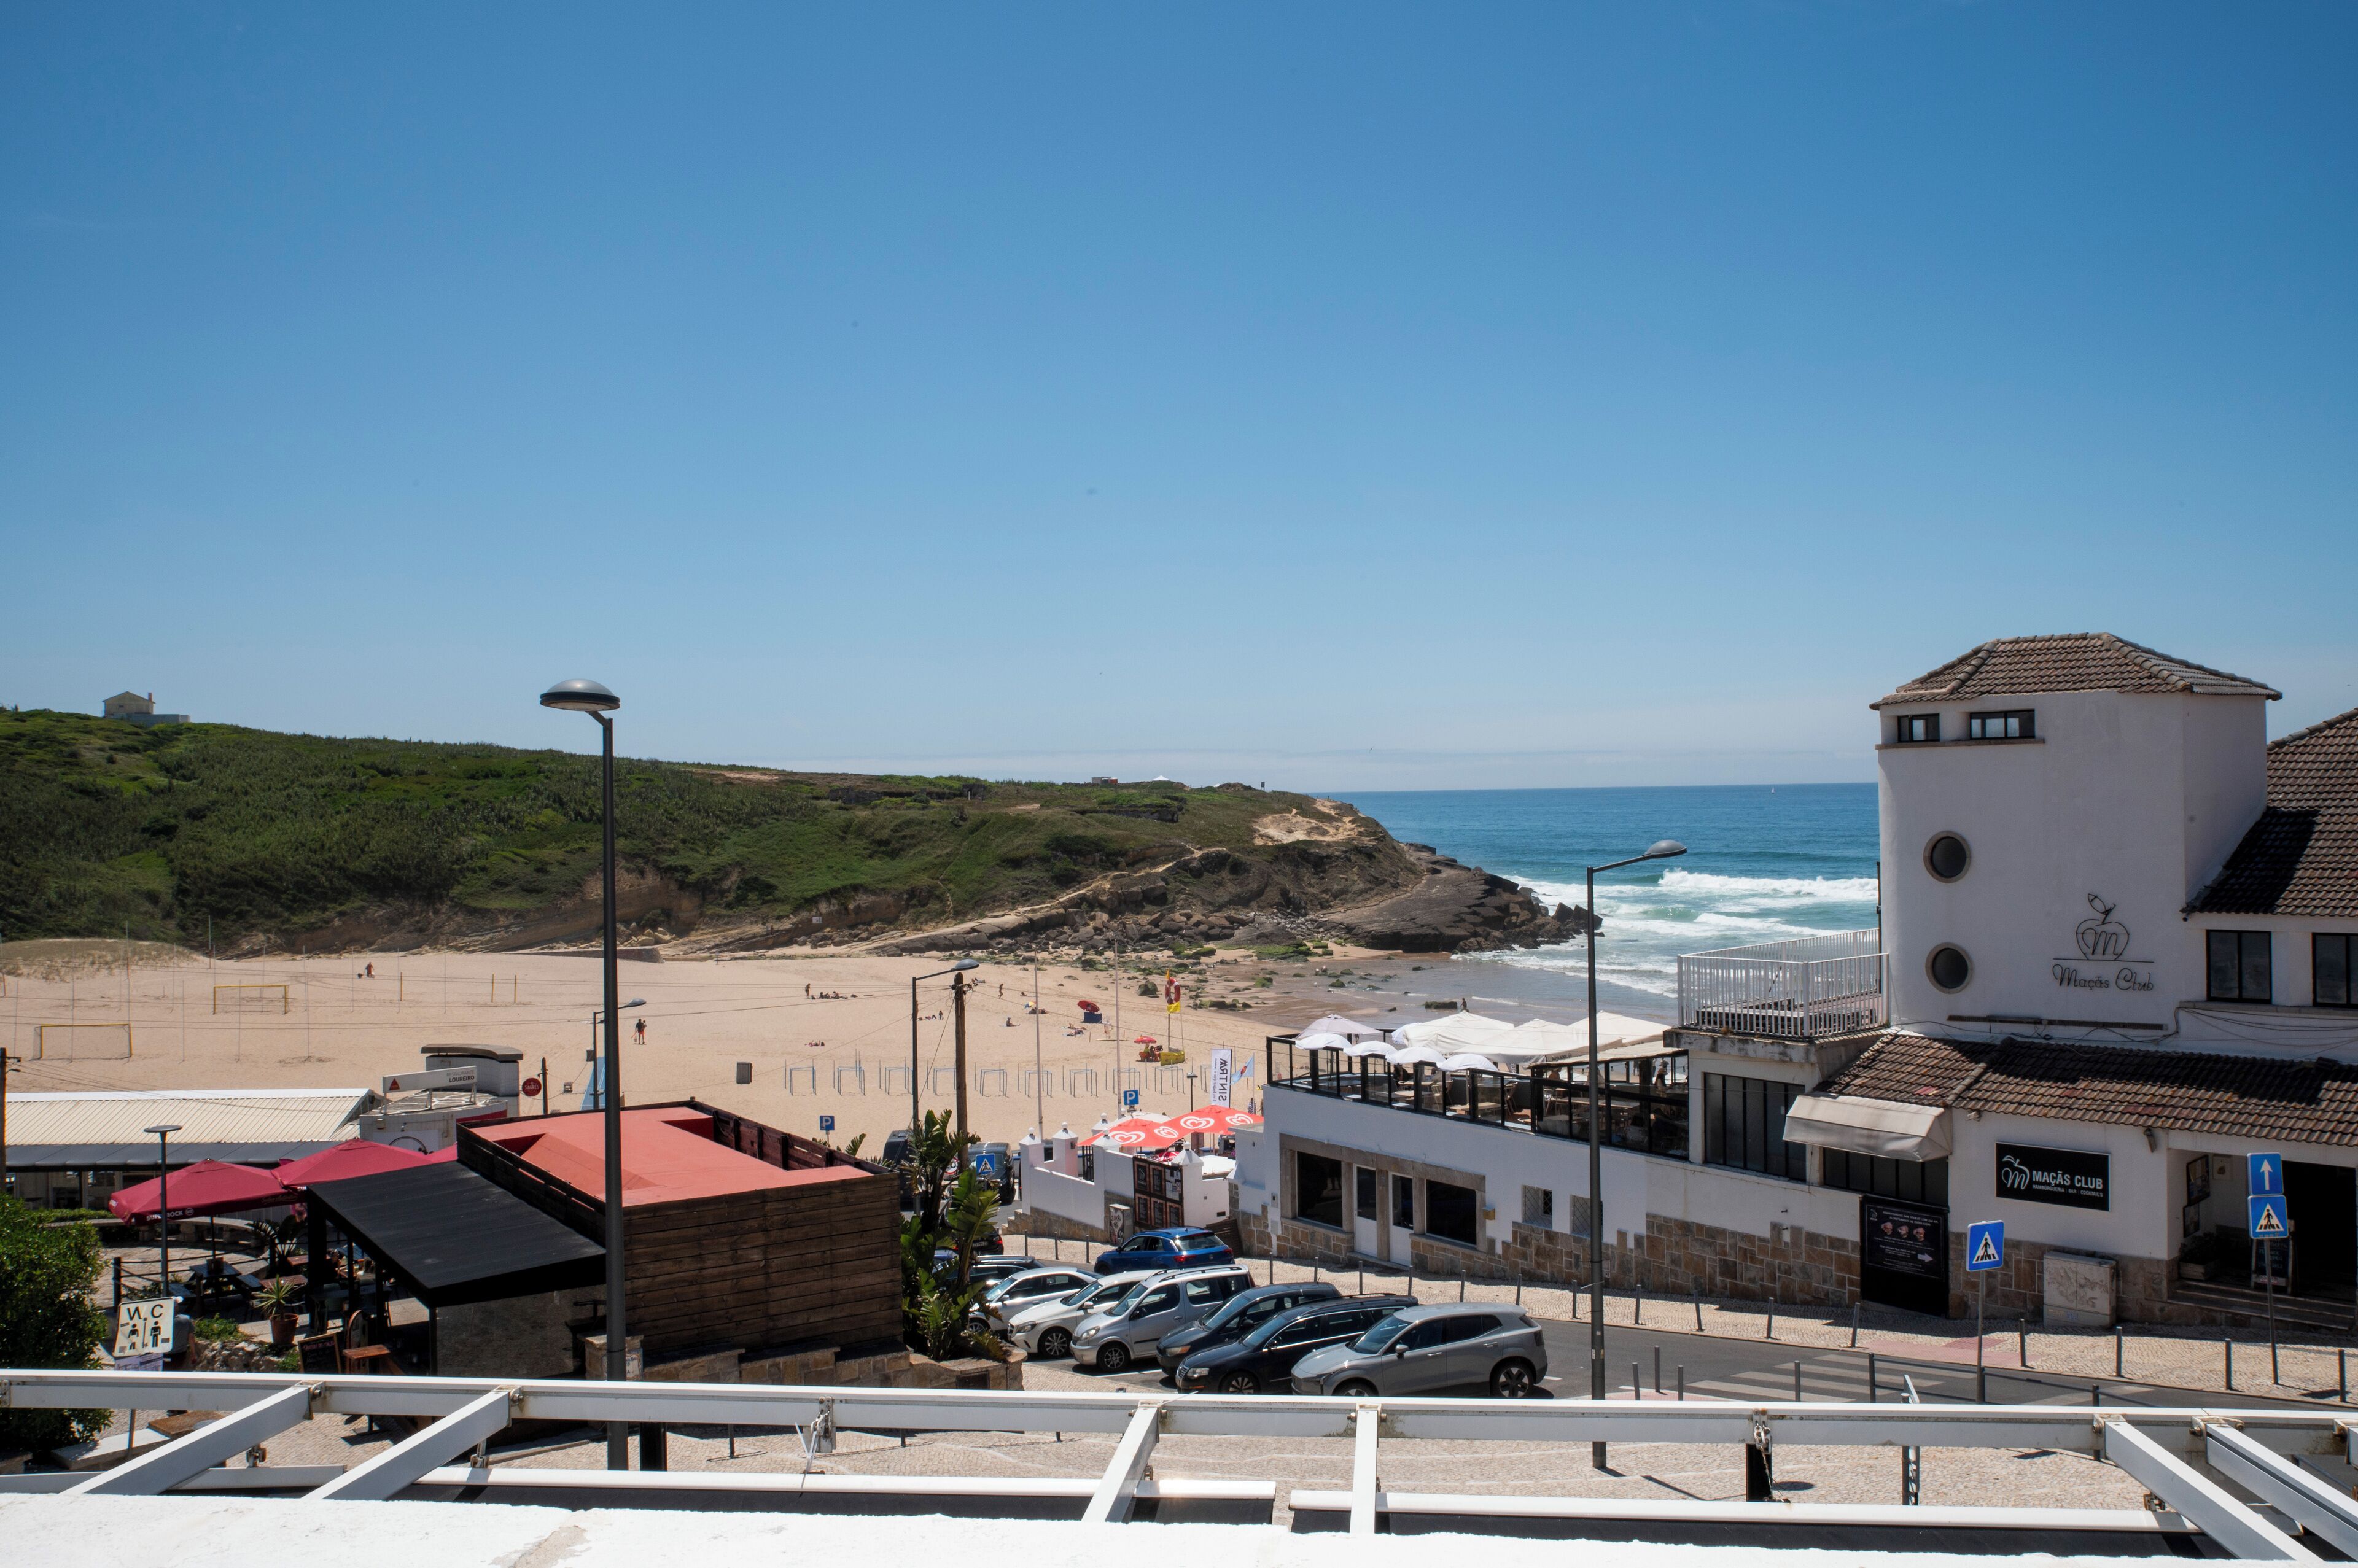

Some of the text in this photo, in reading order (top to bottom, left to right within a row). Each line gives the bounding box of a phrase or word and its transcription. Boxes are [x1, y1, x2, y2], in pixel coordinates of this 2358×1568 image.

[2052, 964, 2154, 991] Maçãs Club
[1127, 1091, 1135, 1104] P
[822, 1116, 831, 1129] P
[2033, 1171, 2103, 1189] MAÇÃS CLUB
